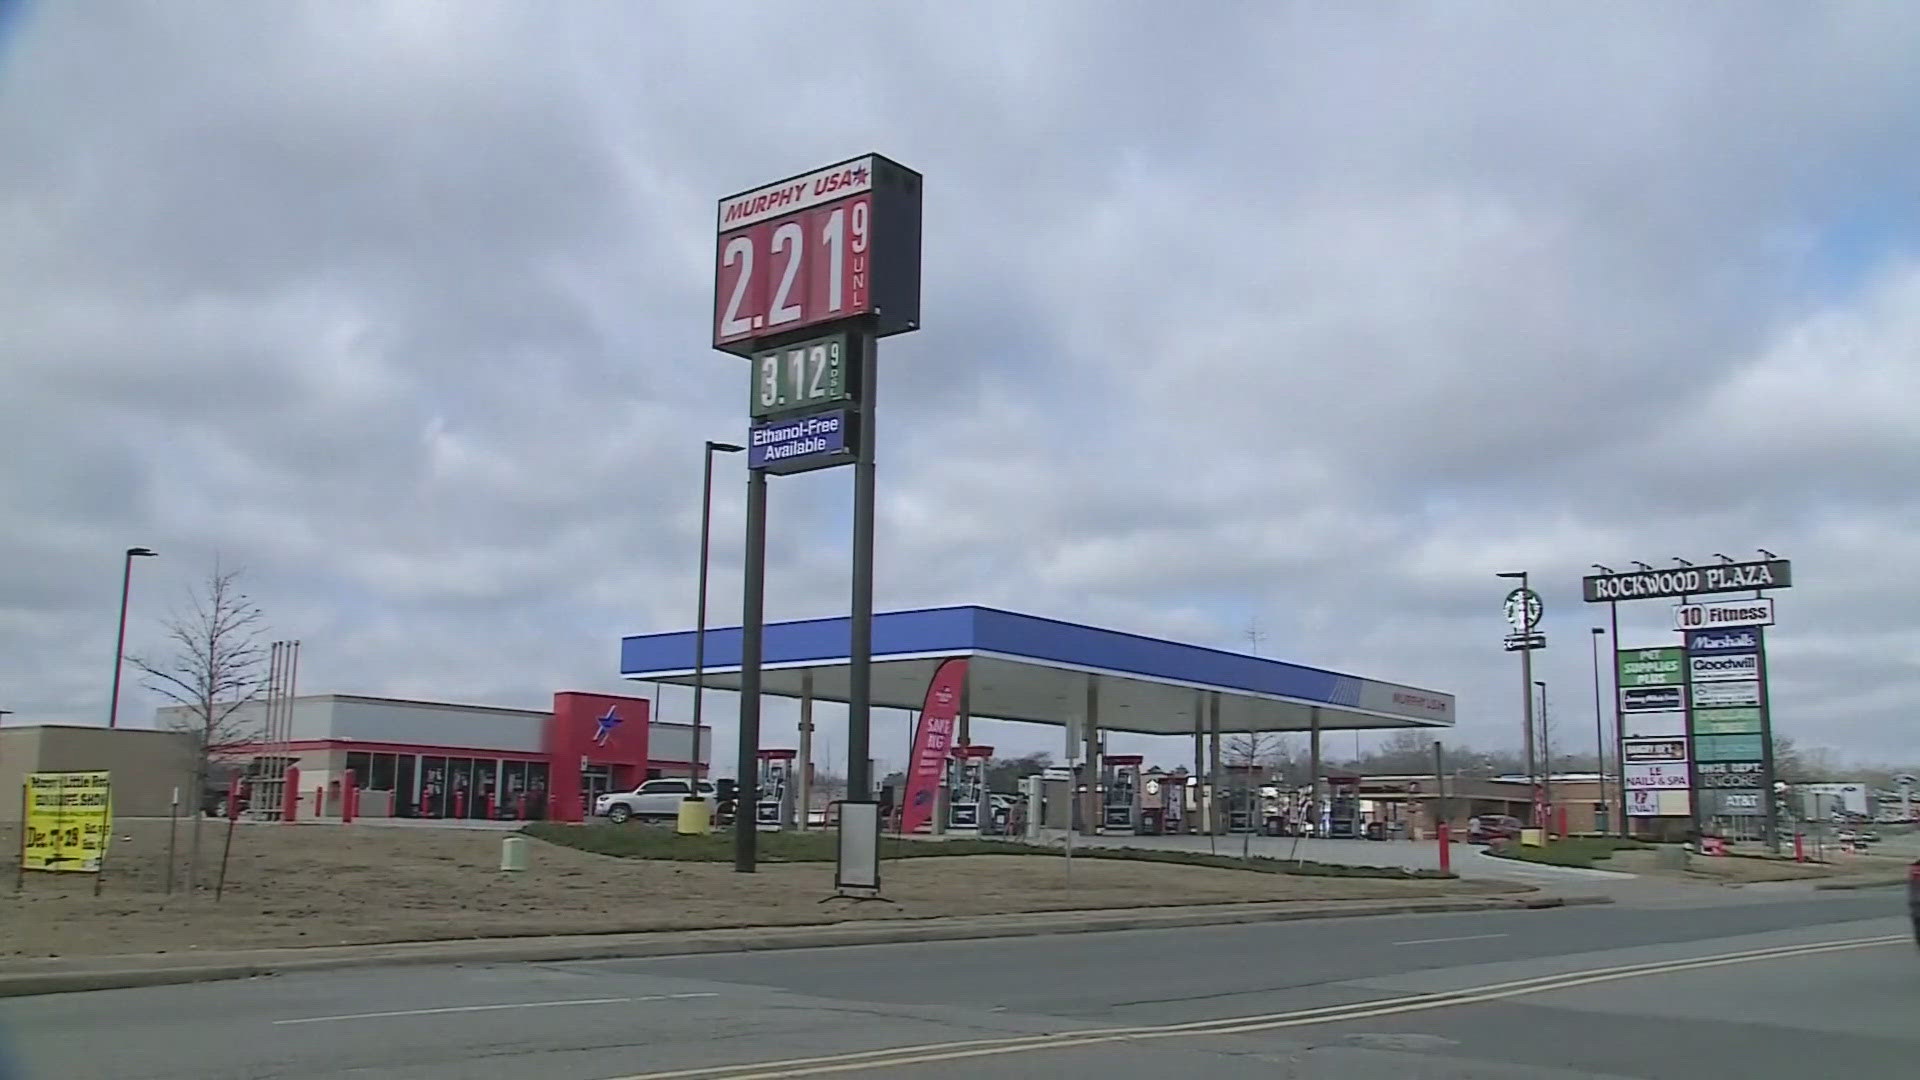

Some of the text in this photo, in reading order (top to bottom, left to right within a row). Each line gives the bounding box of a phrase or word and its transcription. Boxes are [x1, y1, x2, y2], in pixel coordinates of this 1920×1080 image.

[725, 169, 852, 223] MURPHY USA
[853, 257, 864, 306] UNL
[761, 346, 827, 407] 3.12
[753, 418, 839, 446] Ethanol-Free
[764, 438, 826, 460] Available
[1595, 565, 1773, 598] ROCKWOOD PLAZA
[1680, 607, 1767, 626] 10 Fitness
[1691, 633, 1756, 649] Marshalls
[1693, 657, 1755, 670] Goodwill
[928, 718, 951, 734] SAVE
[1650, 768, 1661, 776] LE
[1626, 777, 1656, 786] NAILS
[1667, 776, 1686, 785] SPA
[1704, 775, 1758, 787] ENCORE
[1725, 795, 1758, 806] AT&T
